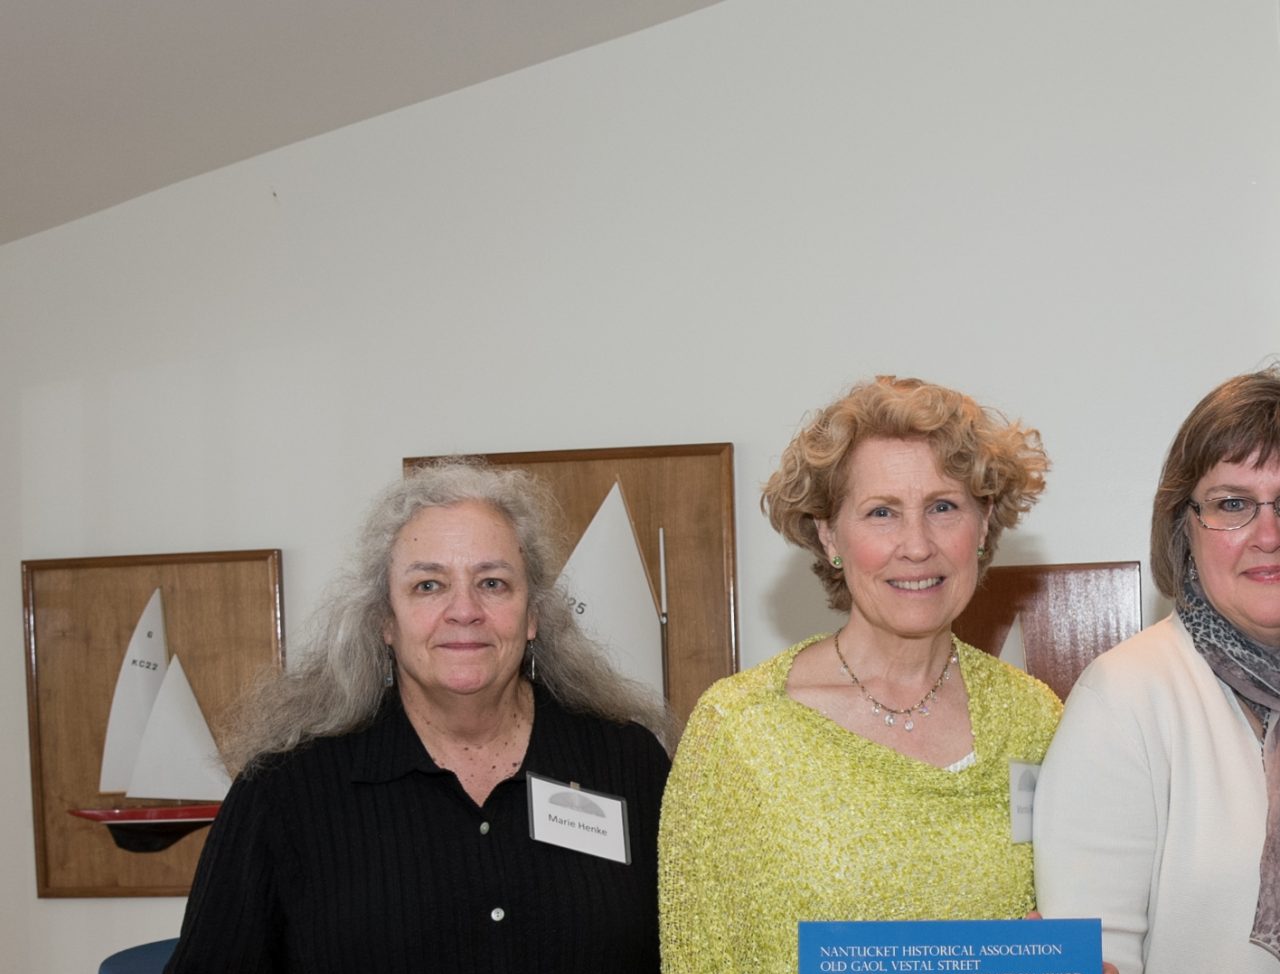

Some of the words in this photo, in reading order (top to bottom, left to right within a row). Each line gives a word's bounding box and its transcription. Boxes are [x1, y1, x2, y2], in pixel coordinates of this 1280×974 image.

[131, 659, 158, 670] KC22
[548, 814, 576, 828] Marie
[578, 823, 608, 836] Henke
[820, 946, 898, 958] NANTUCKET
[902, 945, 975, 957] HISTORICAL
[980, 944, 1062, 956] ASSOCIATION
[820, 961, 847, 972] OLD
[851, 960, 887, 973] GAOL,
[891, 960, 935, 972] VESTAL
[938, 960, 981, 971] STREET
